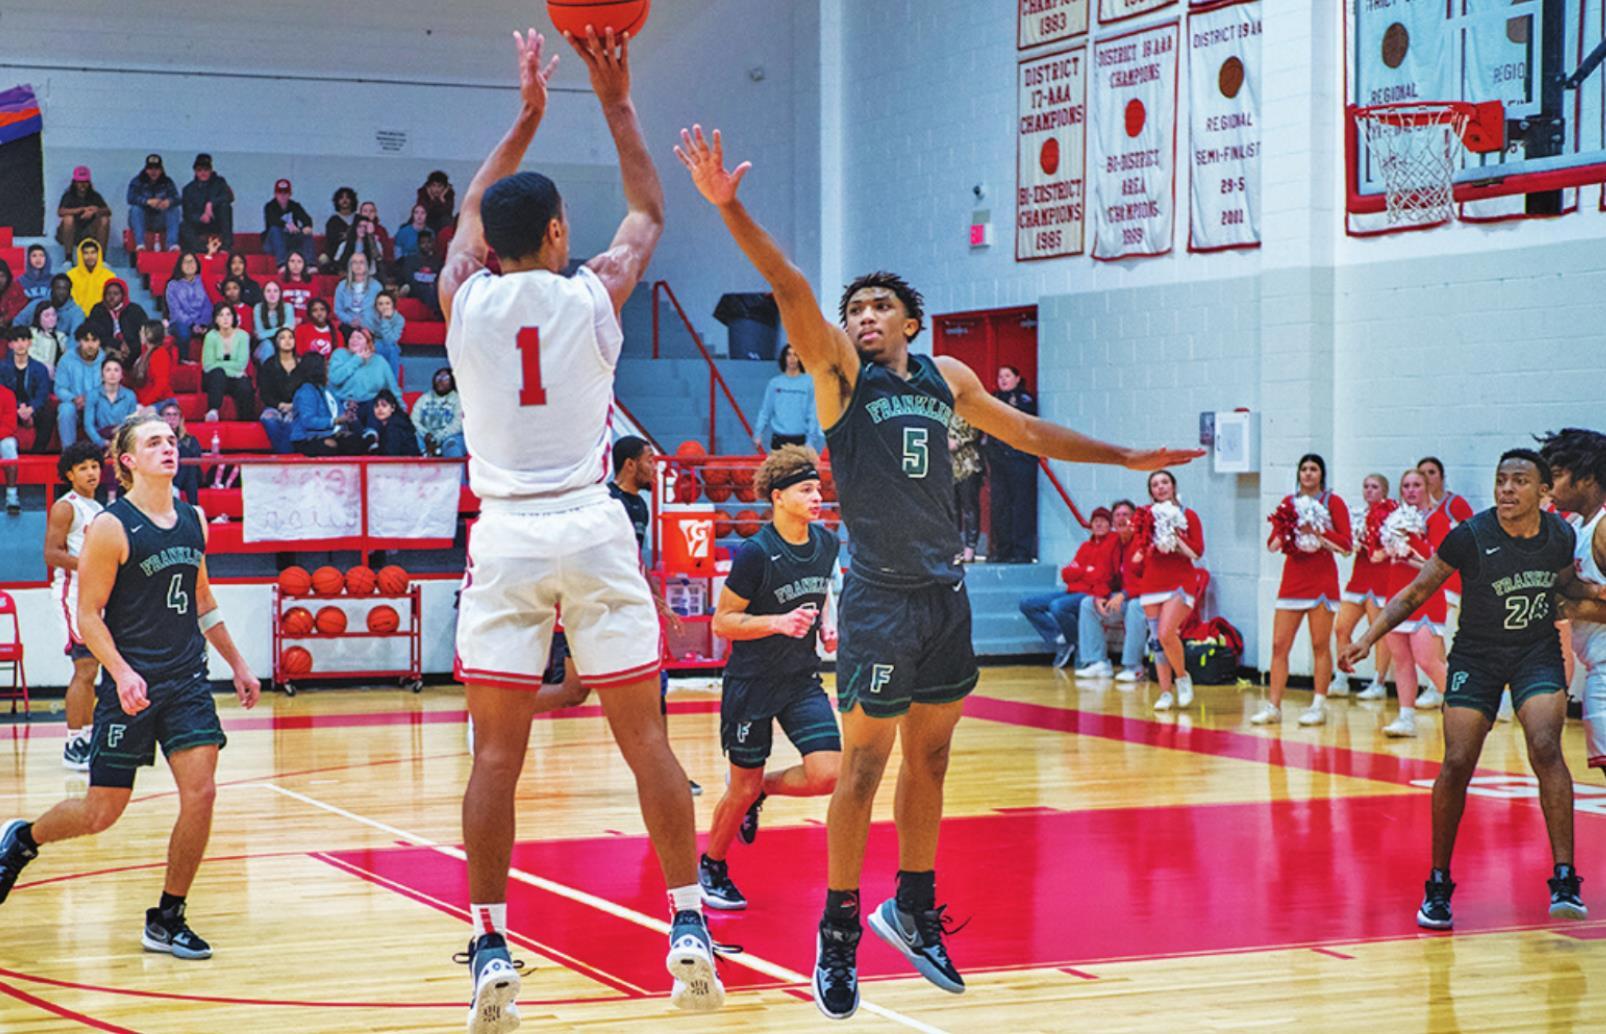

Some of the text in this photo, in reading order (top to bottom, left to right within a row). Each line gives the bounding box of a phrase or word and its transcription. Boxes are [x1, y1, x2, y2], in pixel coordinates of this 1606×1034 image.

[1040, 12, 1067, 36] 1983
[1193, 25, 1235, 48] DISTRICT
[1099, 44, 1136, 67] DISTRICT
[1025, 57, 1079, 87] DISTRICT
[1110, 63, 1160, 88] CHAMPIONS
[1031, 84, 1071, 109] 17-AAA
[1371, 82, 1418, 106] REGIONAL
[1021, 105, 1082, 135] CHAMPIONS
[1207, 112, 1253, 132] REGIONAL
[1106, 149, 1159, 173] BI-DISTRICT
[1019, 179, 1081, 206] BI-DISTRICT
[1121, 176, 1146, 195] AREA
[1018, 203, 1082, 228] CHAMPIONS
[1108, 201, 1158, 223] CHAMPIONS
[516, 326, 547, 407] 1
[902, 427, 928, 478] 5
[166, 573, 189, 615] 4
[870, 664, 894, 693] F
[1451, 671, 1469, 692] F
[108, 723, 127, 748] F
